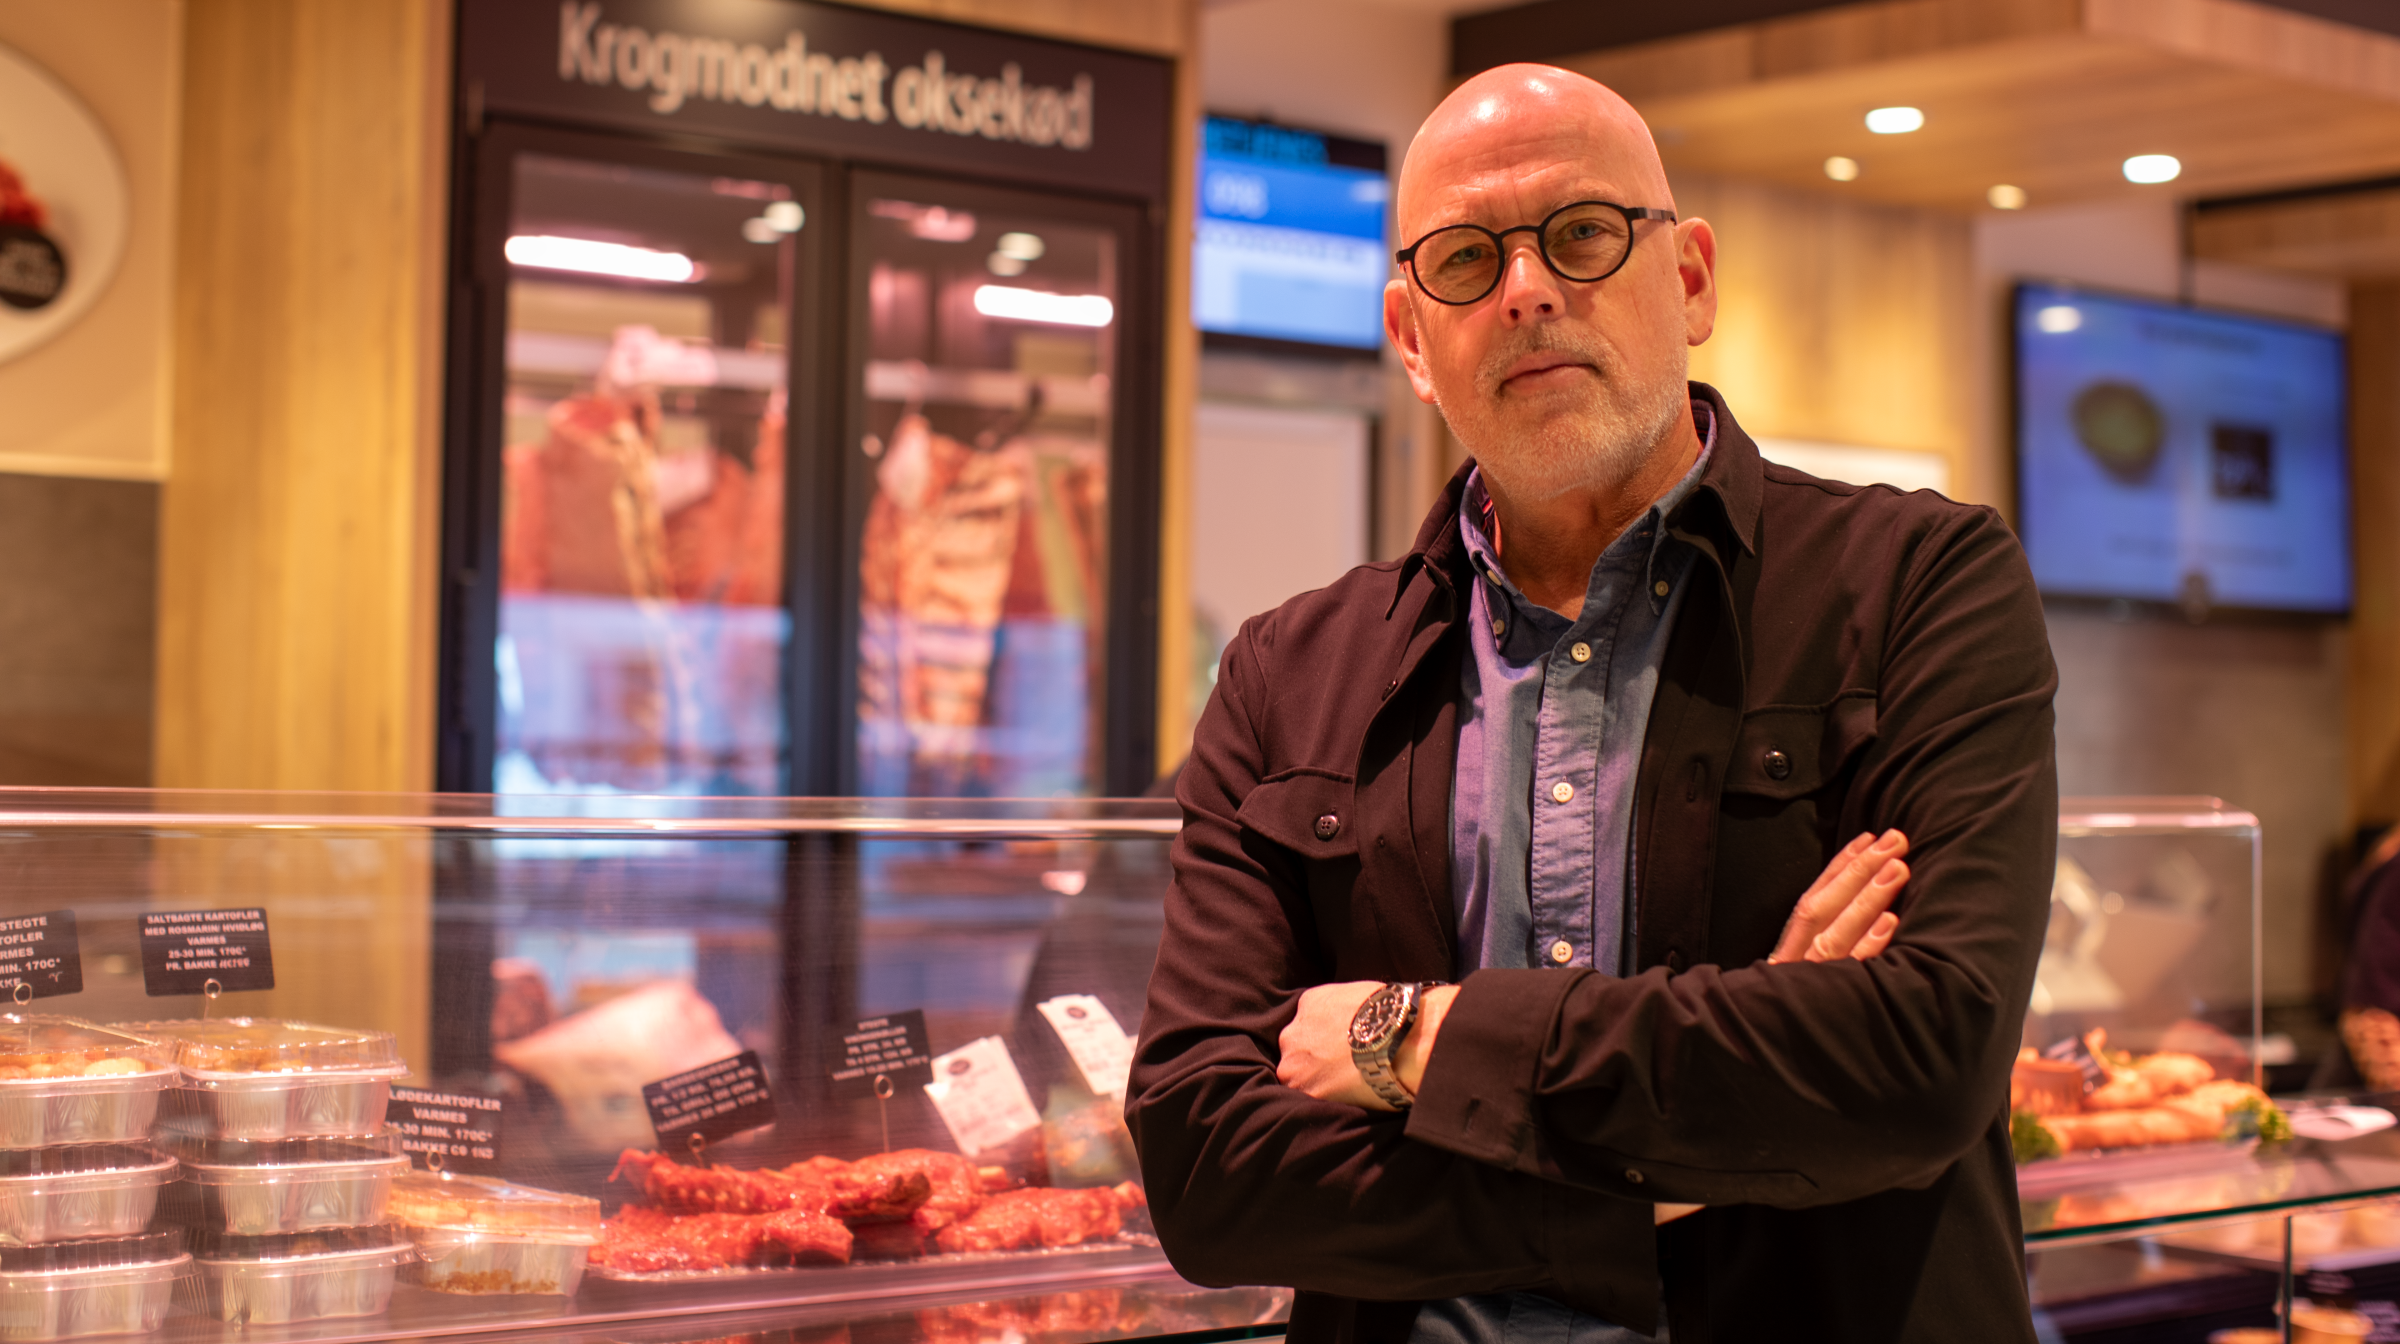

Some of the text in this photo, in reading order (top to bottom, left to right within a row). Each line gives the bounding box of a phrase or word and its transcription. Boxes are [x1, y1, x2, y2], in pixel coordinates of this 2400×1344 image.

[558, 1, 890, 124] Krogmodnet
[893, 49, 1093, 151] oksekød
[147, 910, 260, 925] SALTBAGTE KARTOFLER
[145, 926, 166, 936] MED
[186, 935, 226, 946] VARMES
[168, 949, 194, 959] 25-30
[195, 947, 218, 958] MIN.
[184, 959, 217, 970] BAKKE
[412, 1107, 468, 1124] VARMES
[421, 1124, 451, 1139] MIN.
[402, 1139, 448, 1155] BAKKE
